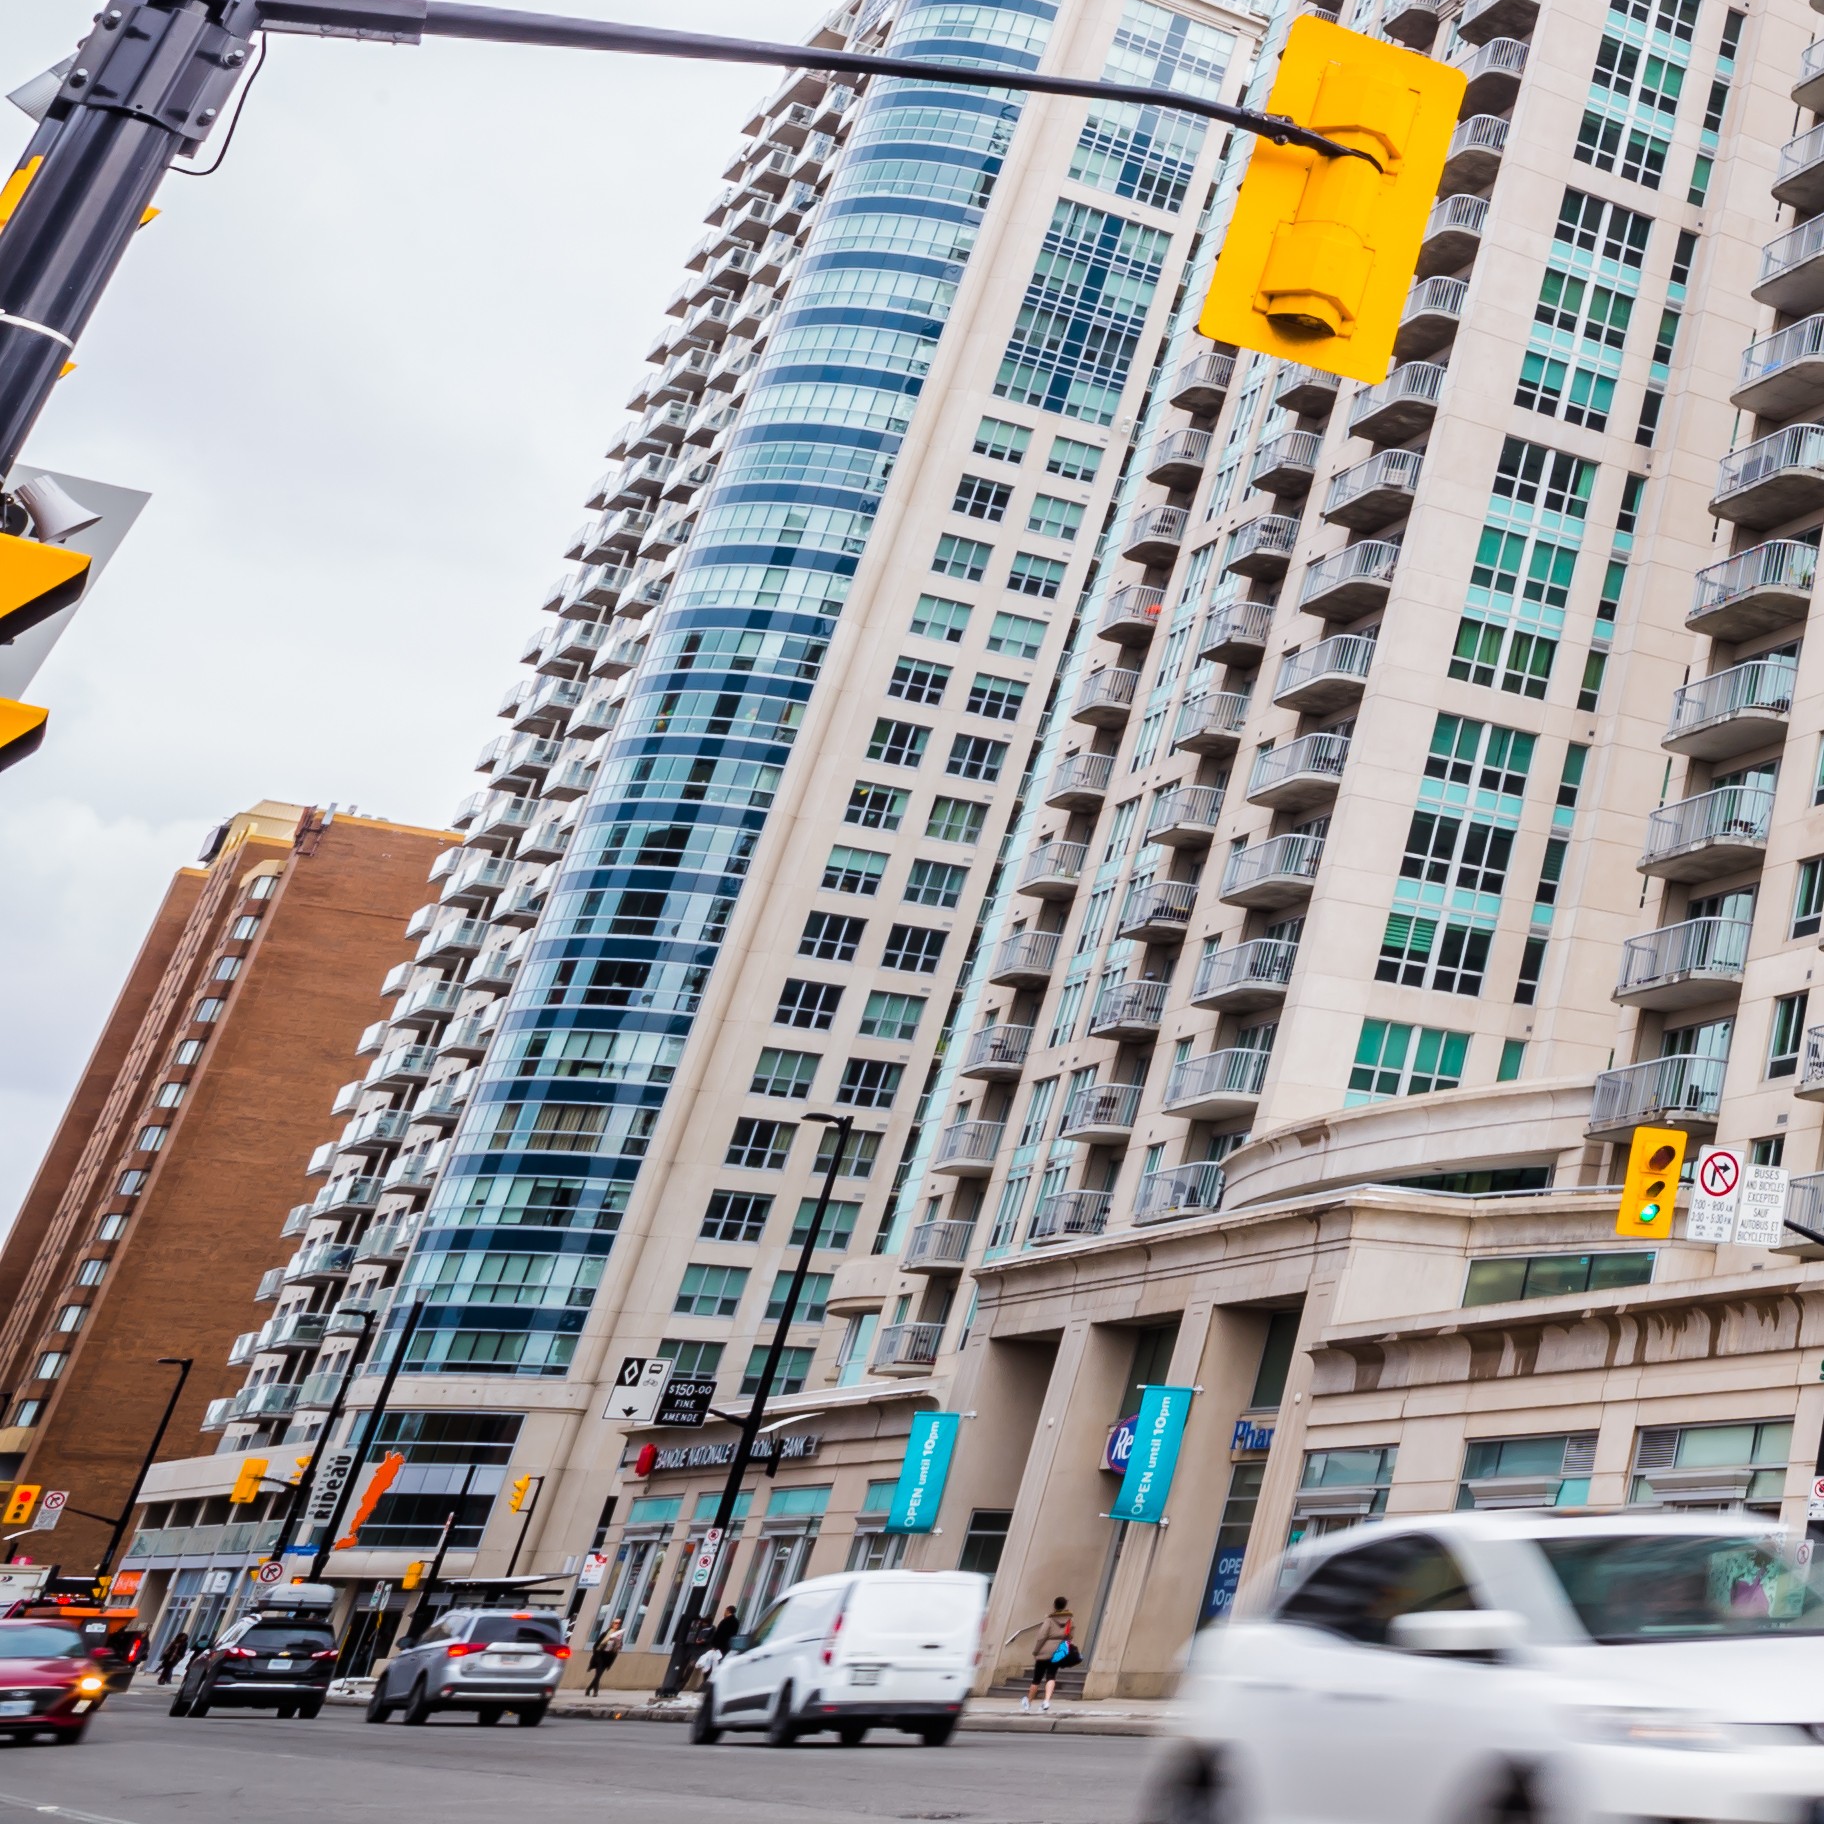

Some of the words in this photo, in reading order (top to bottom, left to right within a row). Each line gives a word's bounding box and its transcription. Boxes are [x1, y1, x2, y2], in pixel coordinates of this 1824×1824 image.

[1754, 1169, 1780, 1180] BUSES
[1745, 1180, 1757, 1190] AND
[1759, 1181, 1785, 1193] BICYCLES
[1747, 1192, 1779, 1204] EXCEPTED
[1753, 1208, 1769, 1218] SAUF
[1740, 1219, 1769, 1230] AUTOBUS
[1770, 1222, 1779, 1231] ET
[1737, 1232, 1778, 1244] BICYCLETTES
[674, 1399, 696, 1409] FINE
[661, 1412, 698, 1423] AMENDE
[1153, 1396, 1172, 1435] 10pm
[922, 1421, 940, 1456] 10pm
[1230, 1420, 1276, 1450] Phar
[654, 1448, 689, 1470] BANQUE
[687, 1443, 734, 1467] NATIONALE
[781, 1436, 808, 1459] BANK
[1148, 1438, 1162, 1468] until
[918, 1458, 931, 1485] until
[1131, 1471, 1154, 1515] OPEN
[904, 1488, 924, 1527] OPEN
[1219, 1558, 1243, 1574] OPE
[1212, 1589, 1235, 1609] 10p
